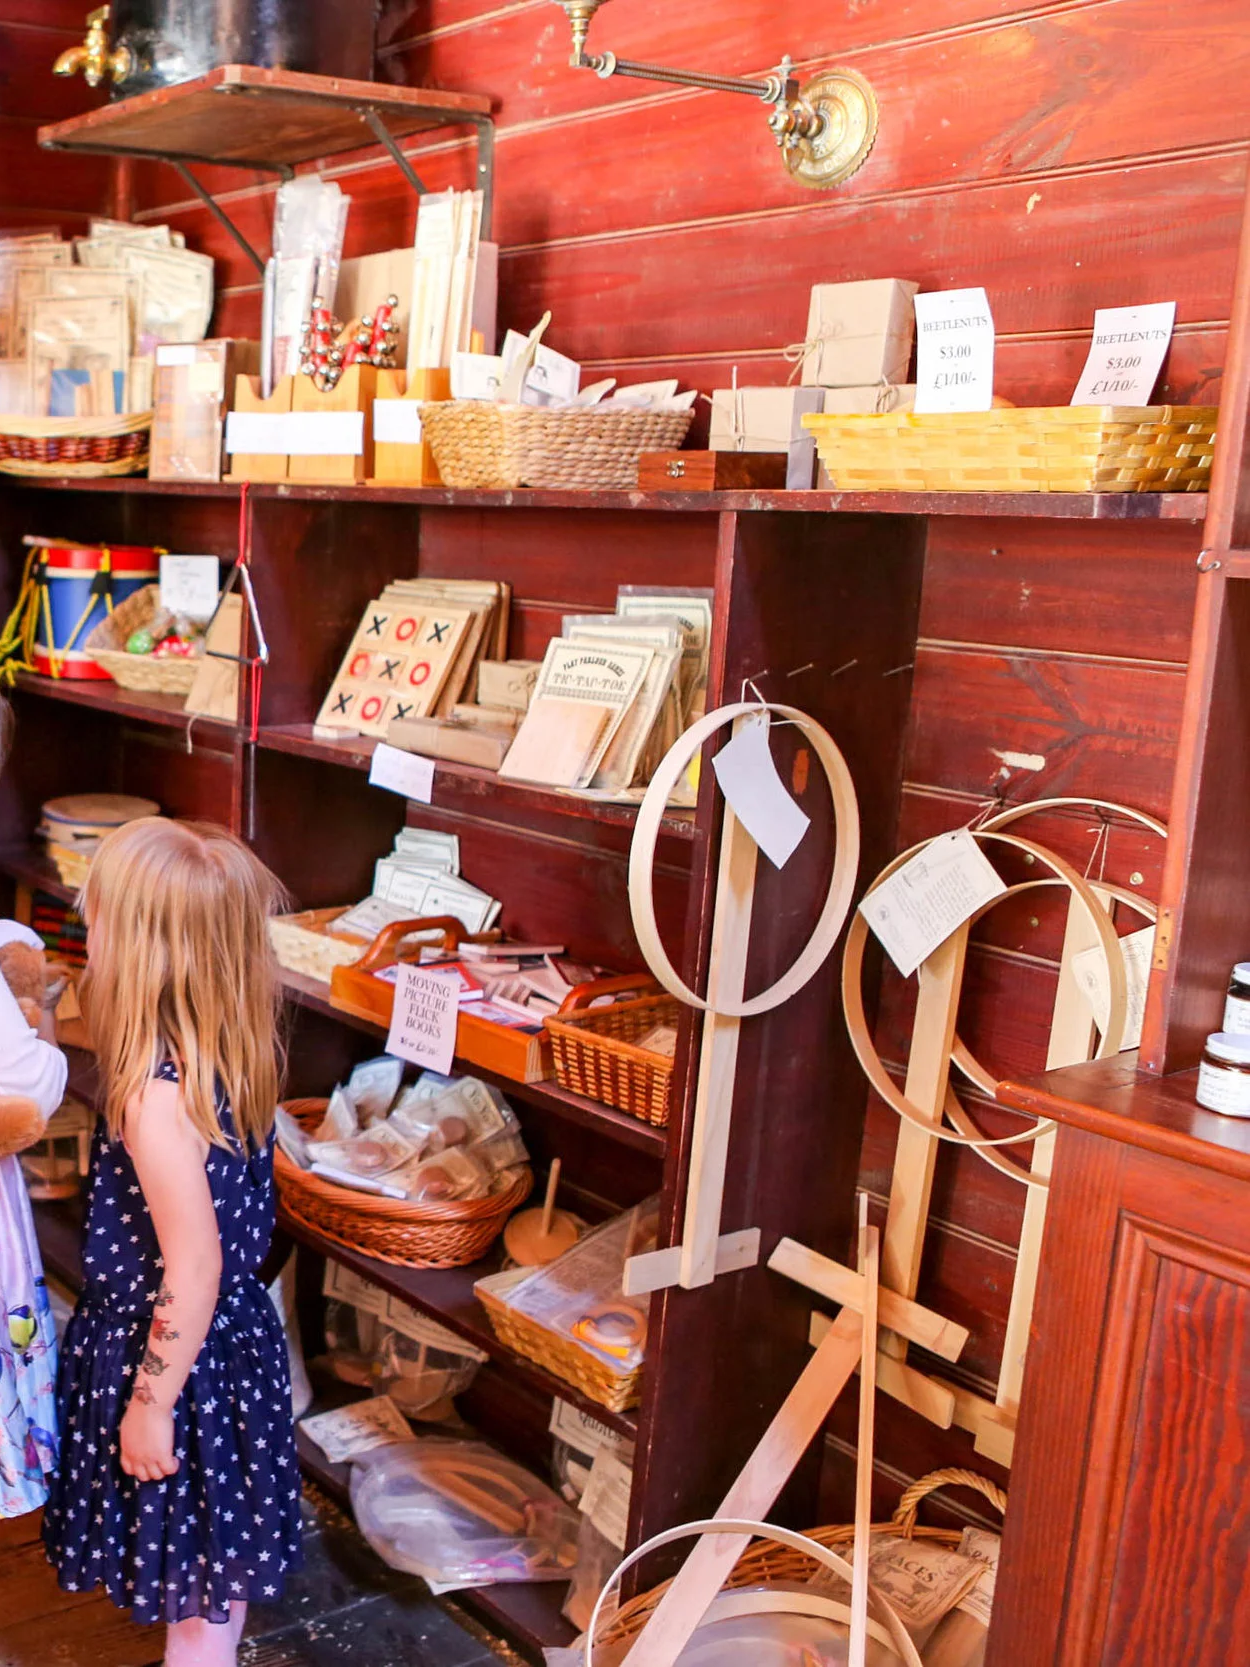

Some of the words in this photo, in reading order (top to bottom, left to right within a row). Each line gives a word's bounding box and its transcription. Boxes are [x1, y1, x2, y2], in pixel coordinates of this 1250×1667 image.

[923, 316, 988, 332] BEETLENUTS
[1096, 329, 1167, 345] BEETLENUTS
[940, 344, 972, 360] $3.00
[1106, 356, 1141, 370] $3.00
[407, 973, 451, 998] MOVING
[404, 987, 448, 1012] PICTURE
[409, 1003, 440, 1024] FLICK
[405, 1016, 441, 1039] BOOKS
